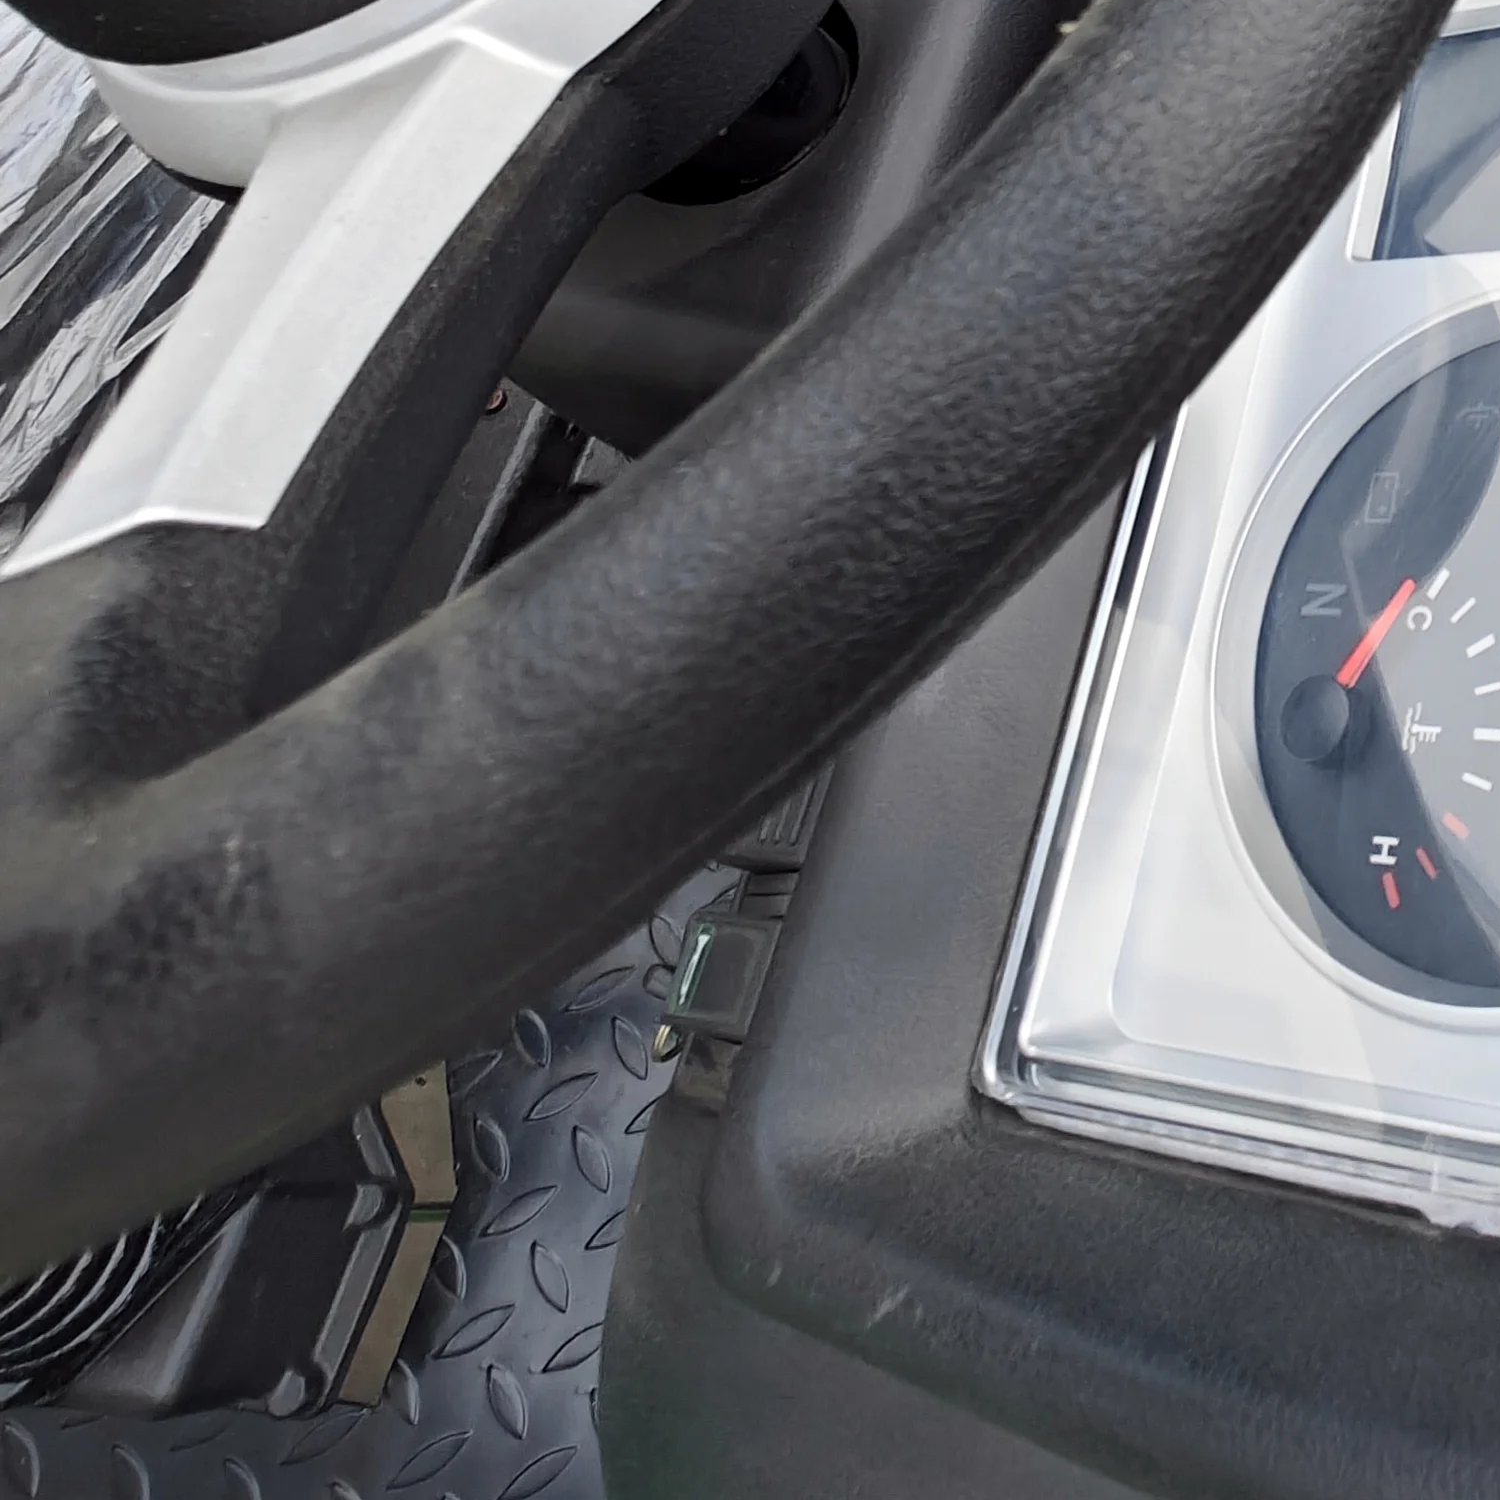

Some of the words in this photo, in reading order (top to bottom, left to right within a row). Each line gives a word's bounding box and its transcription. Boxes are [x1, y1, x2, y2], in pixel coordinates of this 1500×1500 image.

[1300, 583, 1347, 616] N
[1406, 606, 1433, 632] C
[1369, 835, 1399, 866] H
